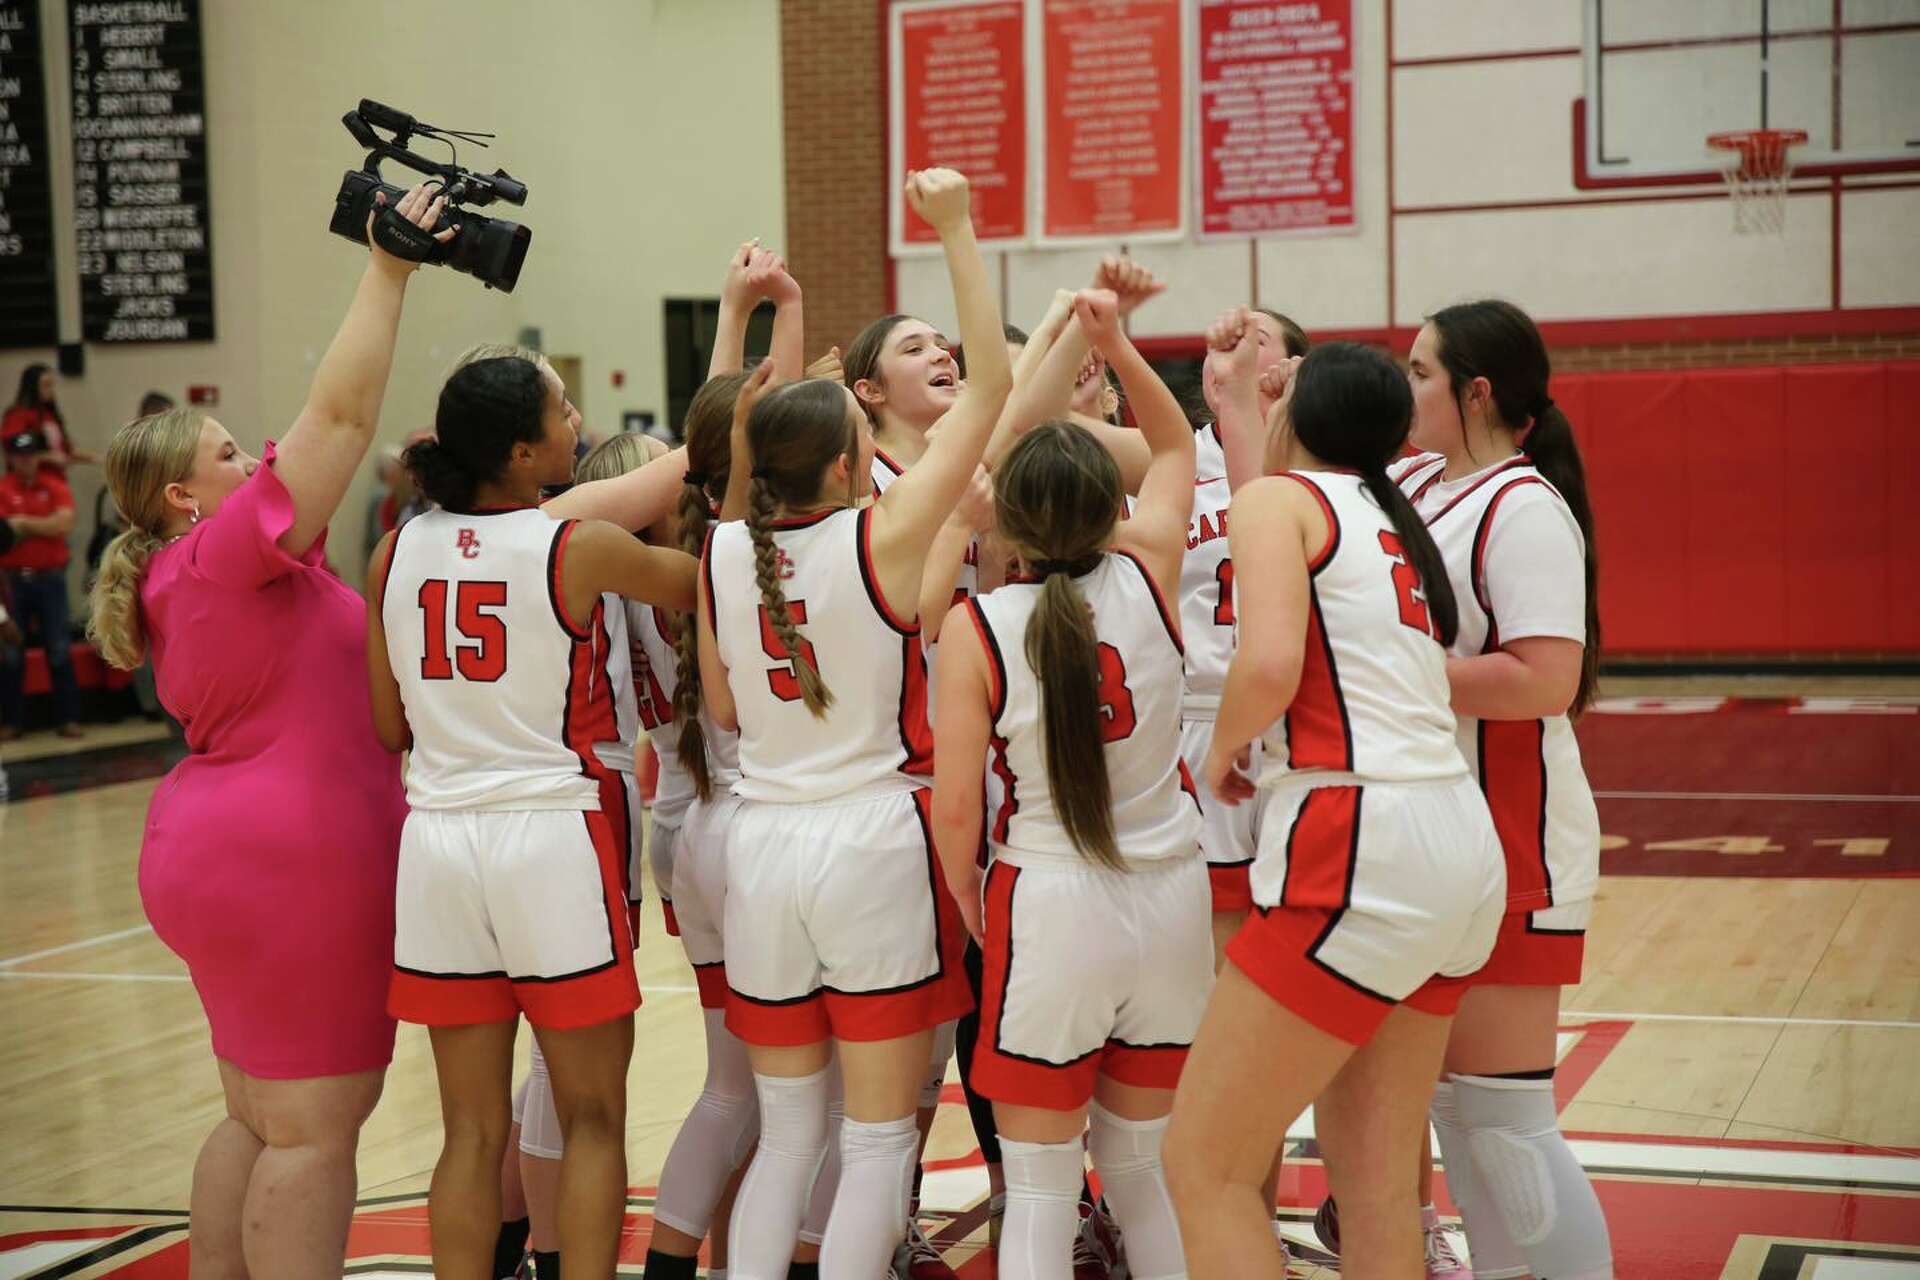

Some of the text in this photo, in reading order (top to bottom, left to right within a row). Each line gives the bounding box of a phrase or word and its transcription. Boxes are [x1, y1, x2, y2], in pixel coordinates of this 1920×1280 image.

[74, 3, 189, 25] BASKETBALL
[102, 48, 162, 70] SMALL
[94, 69, 182, 93] STERLING
[92, 113, 203, 138] CUNNINGHAM
[98, 137, 192, 161] CAMPBELL
[108, 183, 181, 206] SASSER
[104, 227, 204, 251] MIDDLETON
[388, 226, 417, 248] SONY
[100, 273, 189, 297] STERLING
[457, 528, 481, 559] BC
[418, 578, 507, 683] 15
[757, 599, 821, 702] 5
